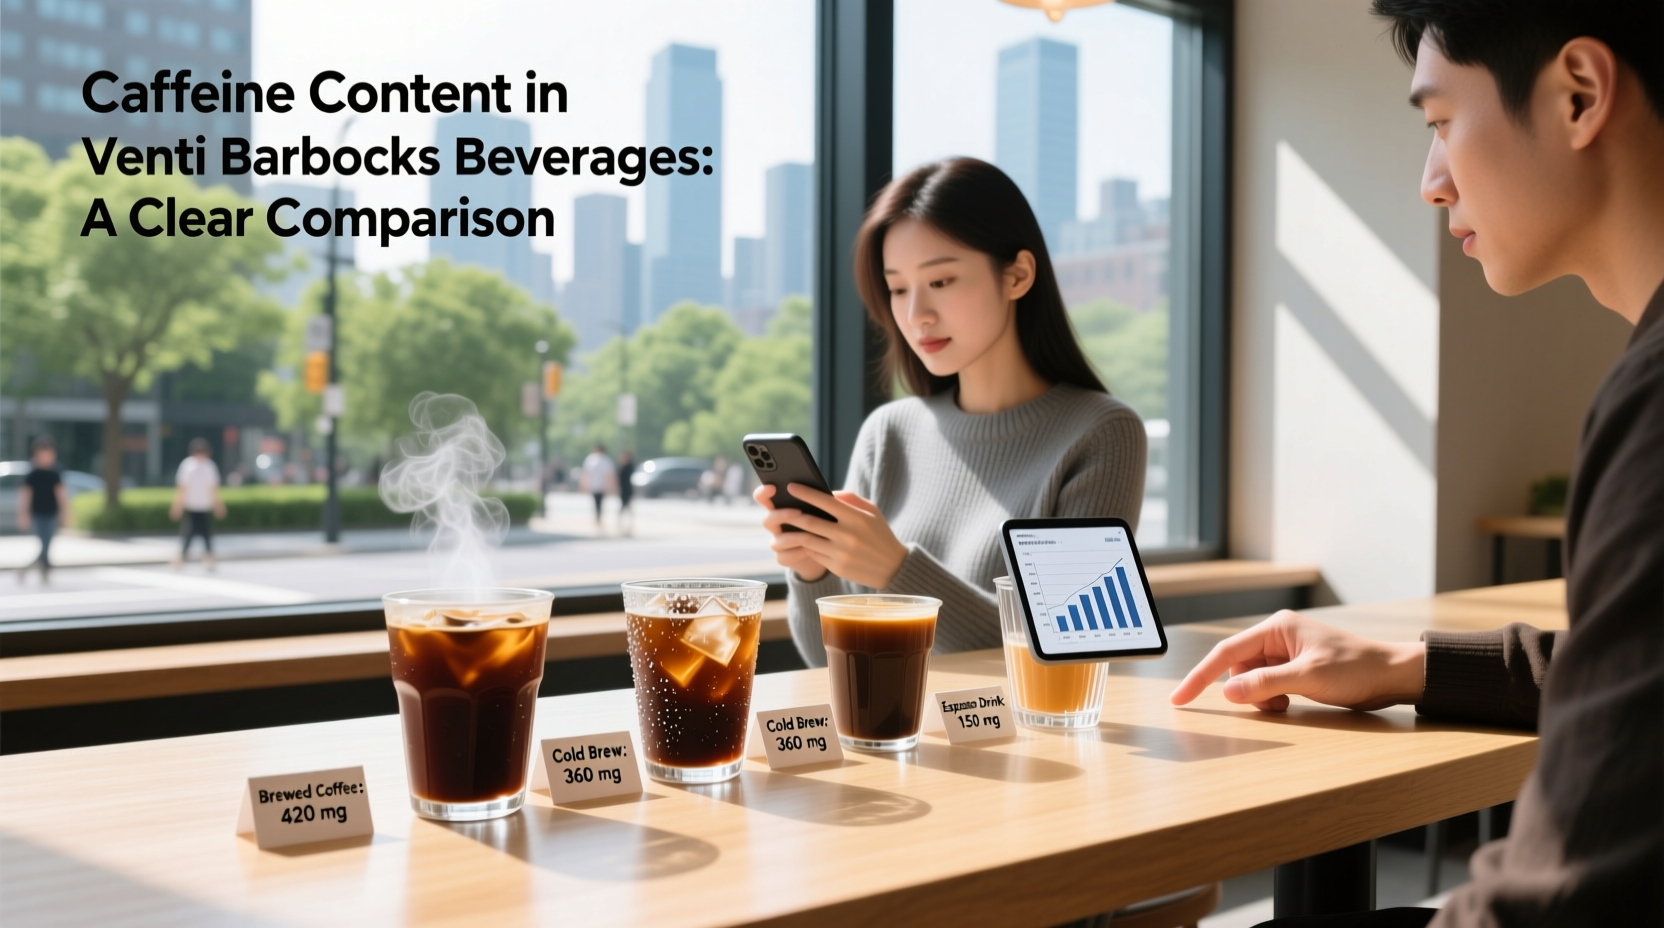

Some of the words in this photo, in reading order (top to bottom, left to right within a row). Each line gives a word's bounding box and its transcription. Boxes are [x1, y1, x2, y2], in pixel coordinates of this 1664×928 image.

[978, 695, 1006, 708] Drink
[766, 717, 794, 733] Cold
[796, 716, 829, 729] Brew:
[957, 714, 980, 728] 150
[775, 735, 803, 752] 360
[806, 736, 827, 752] mg
[552, 744, 585, 763] Cold
[587, 745, 627, 760] Brew:
[563, 766, 594, 785] 360
[598, 768, 622, 784] mg
[258, 783, 312, 804] Brewed
[315, 781, 364, 798] Coffee:
[281, 804, 316, 825] 420
[319, 805, 348, 823] mg
